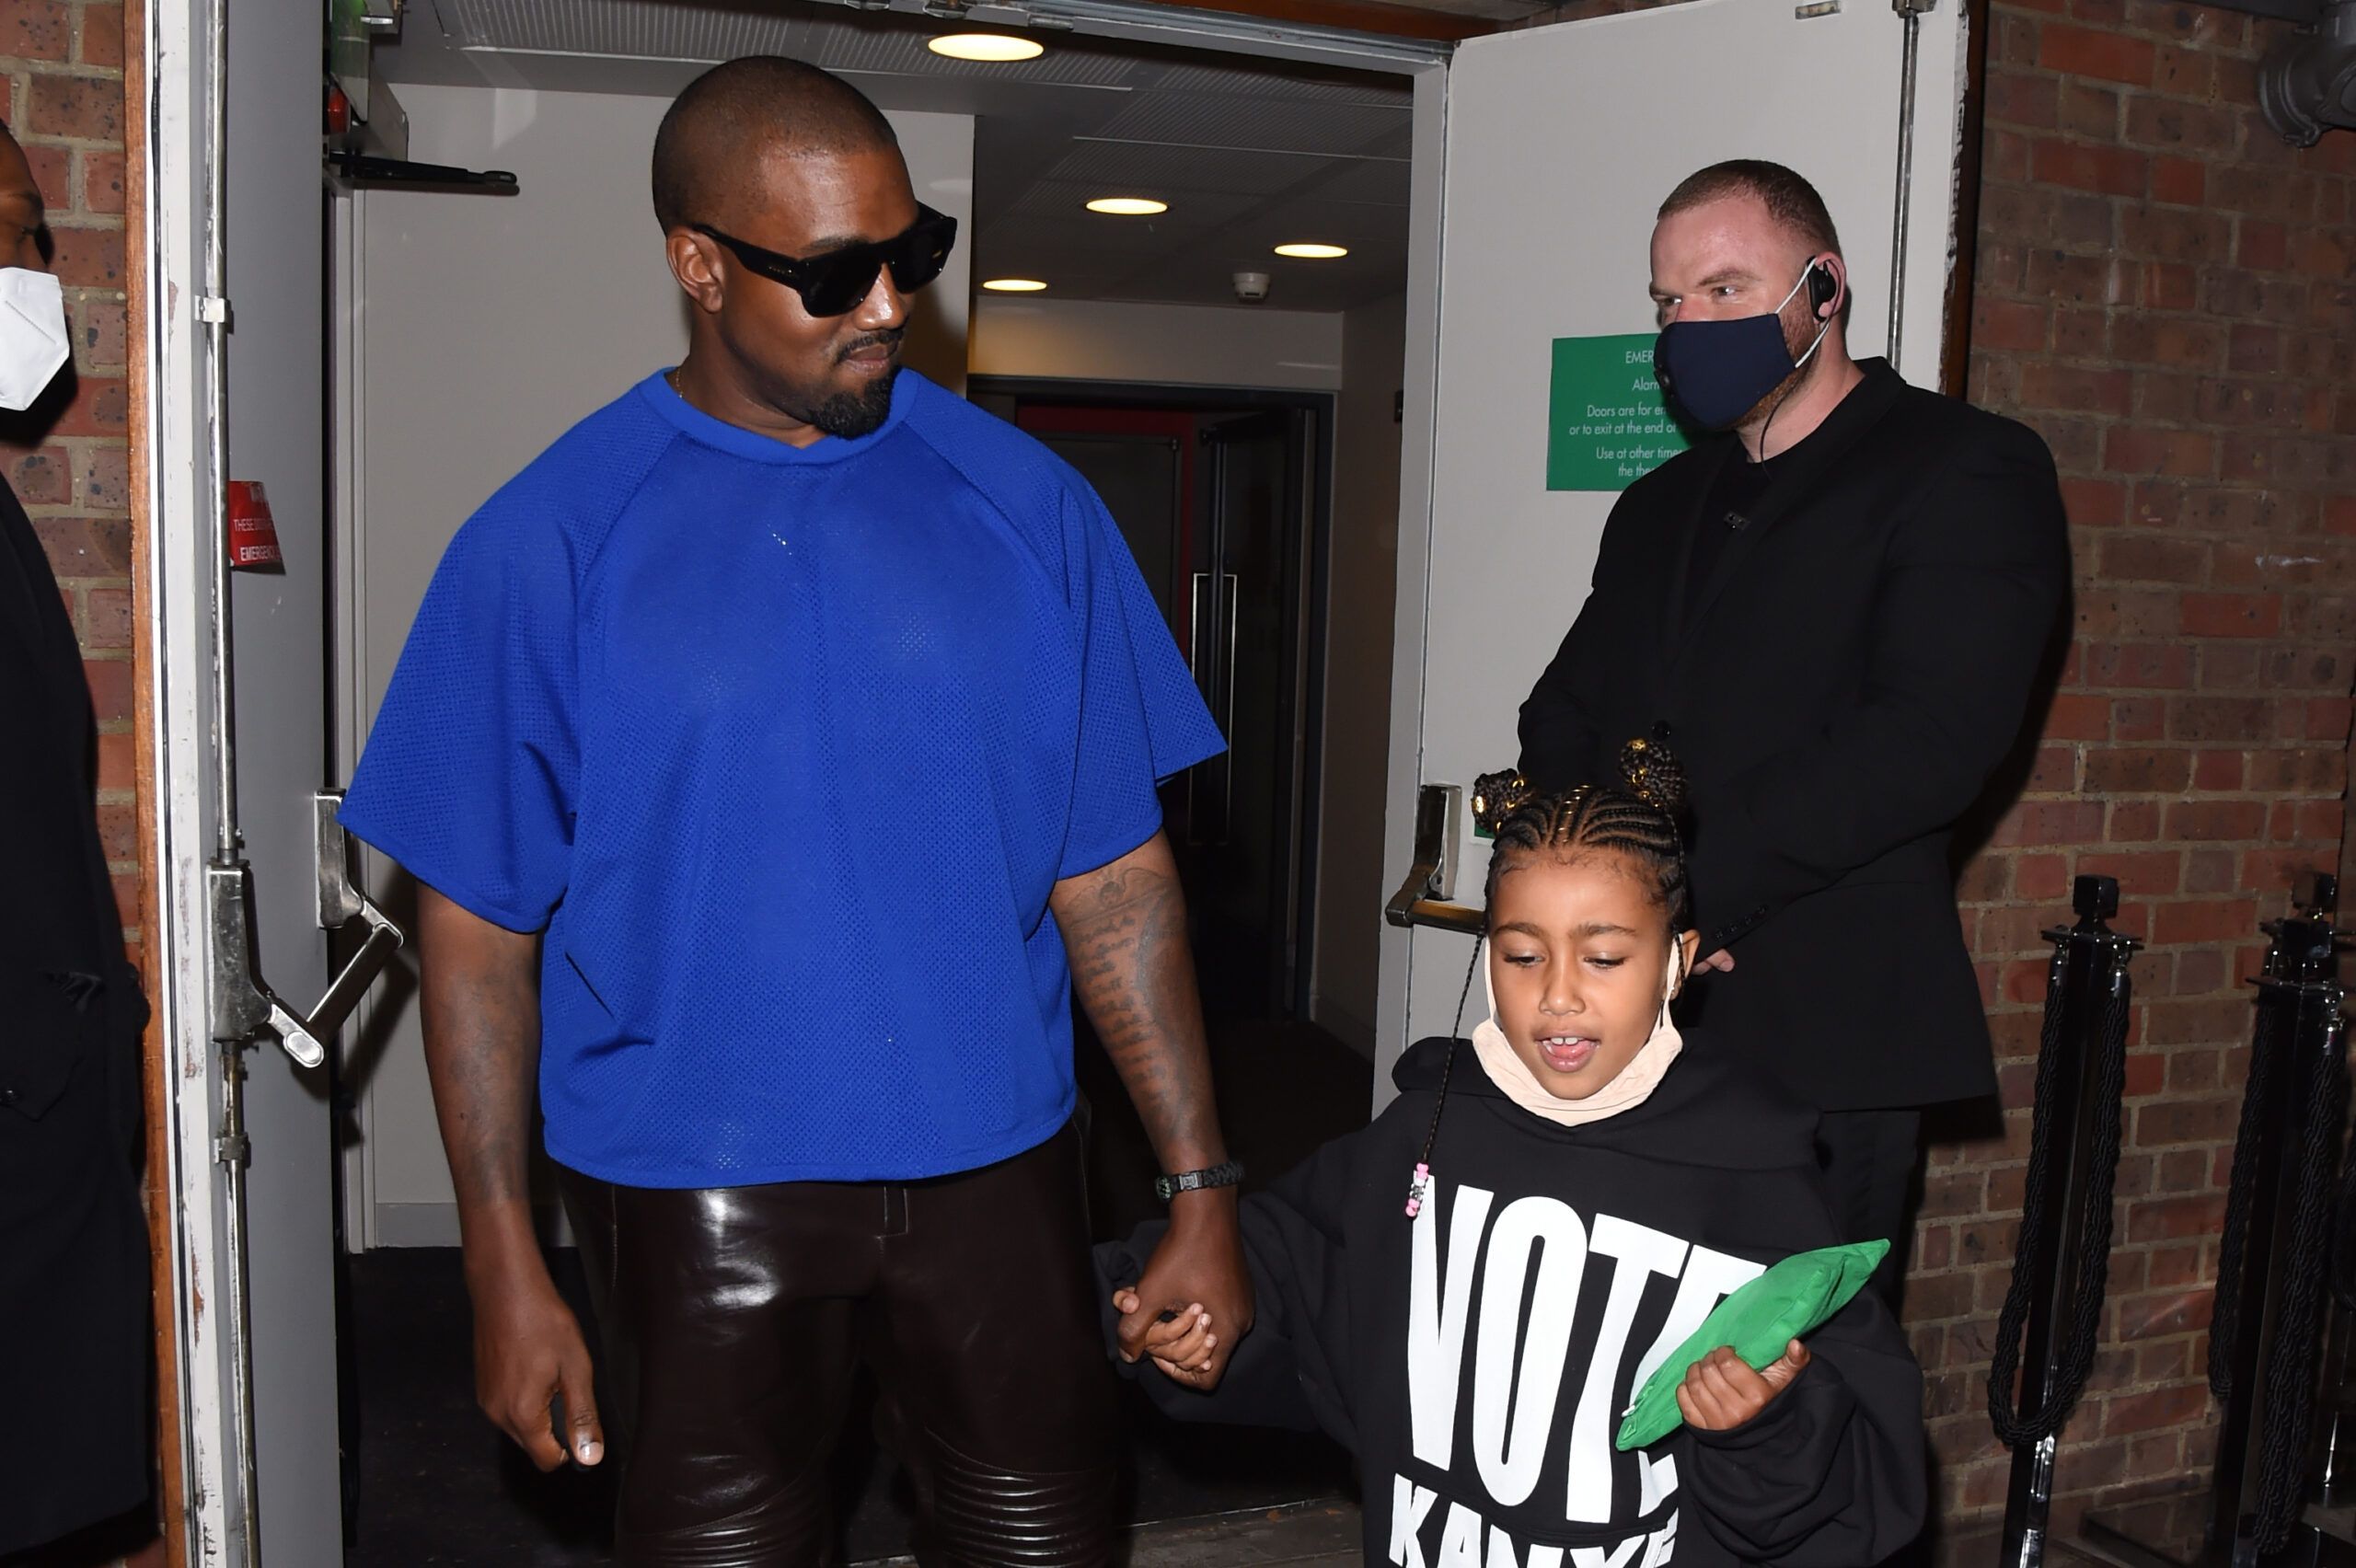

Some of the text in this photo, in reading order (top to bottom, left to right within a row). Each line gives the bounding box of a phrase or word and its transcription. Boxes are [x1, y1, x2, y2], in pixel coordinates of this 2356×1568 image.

[1625, 351, 1655, 364] EMER
[1587, 404, 1615, 417] Doors
[1618, 407, 1634, 417] are
[1637, 401, 1651, 416] for
[1569, 426, 1580, 435] or
[1582, 423, 1592, 434] to
[1594, 423, 1611, 434] exit
[1614, 423, 1624, 434] at
[1627, 421, 1642, 433] the
[1645, 420, 1663, 433] end
[1596, 446, 1614, 459] Use
[1616, 448, 1626, 459] at
[1629, 444, 1655, 459] other
[1618, 463, 1634, 477] the
